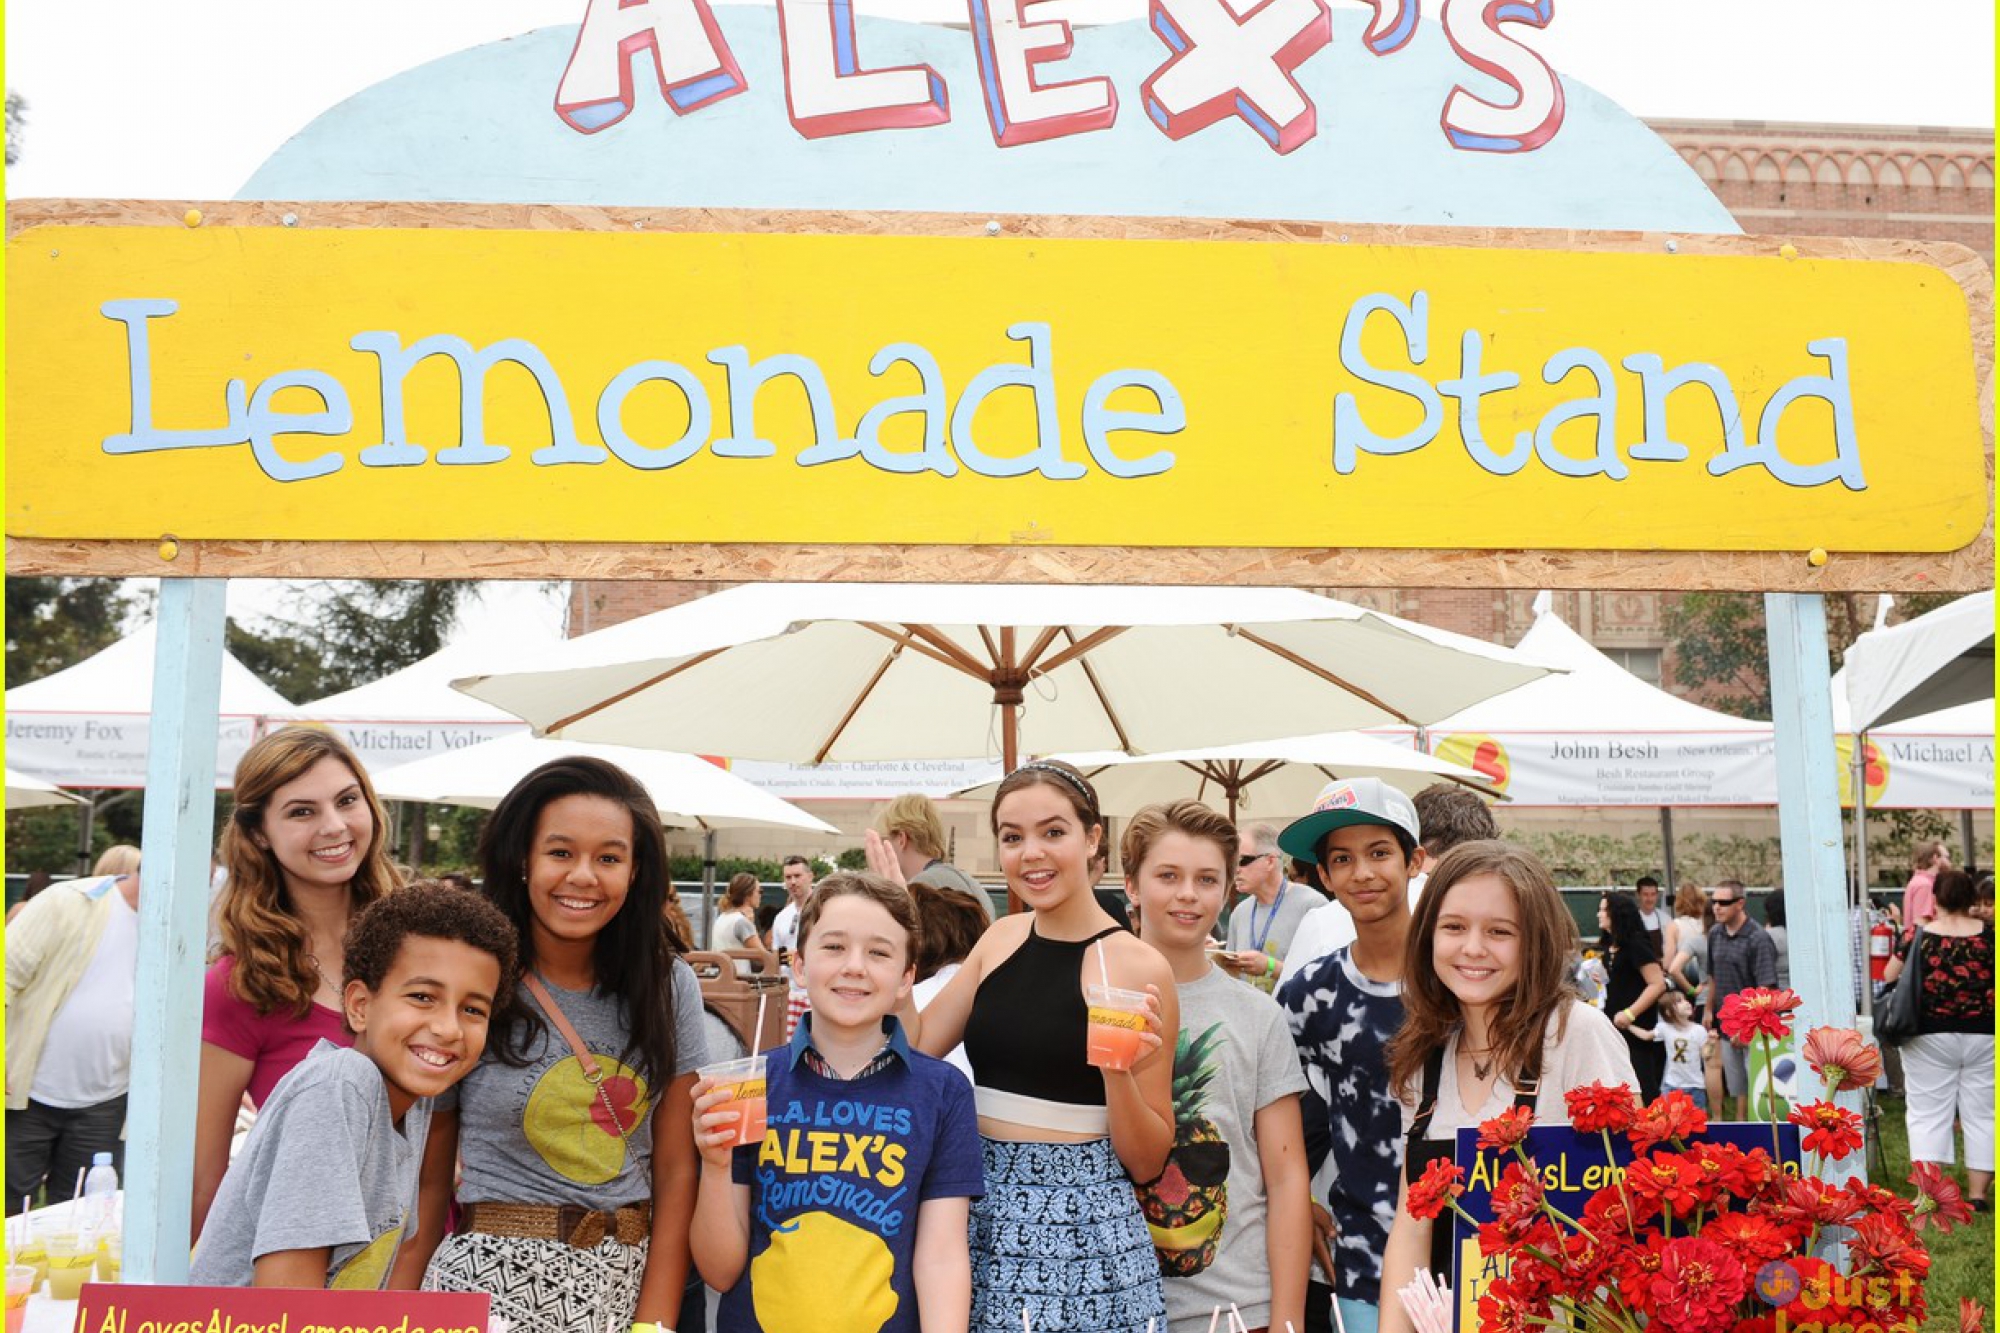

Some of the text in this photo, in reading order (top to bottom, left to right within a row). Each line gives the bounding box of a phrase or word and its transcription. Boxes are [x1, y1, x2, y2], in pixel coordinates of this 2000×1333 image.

[100, 290, 1869, 492] Lemonade Stand
[5, 719, 124, 745] Jeremy Fox
[349, 729, 494, 750] Michael Volt
[1550, 741, 1600, 760] John
[1608, 741, 1659, 760] Besh
[1891, 742, 1973, 763] Michael
[901, 762, 911, 772] &
[914, 761, 965, 772] Cleveland
[1596, 768, 1715, 781] Besh Restaurant Group
[814, 1100, 912, 1135] LOVES
[759, 1128, 907, 1188] ALEX'S
[756, 1168, 908, 1237] Lemonade
